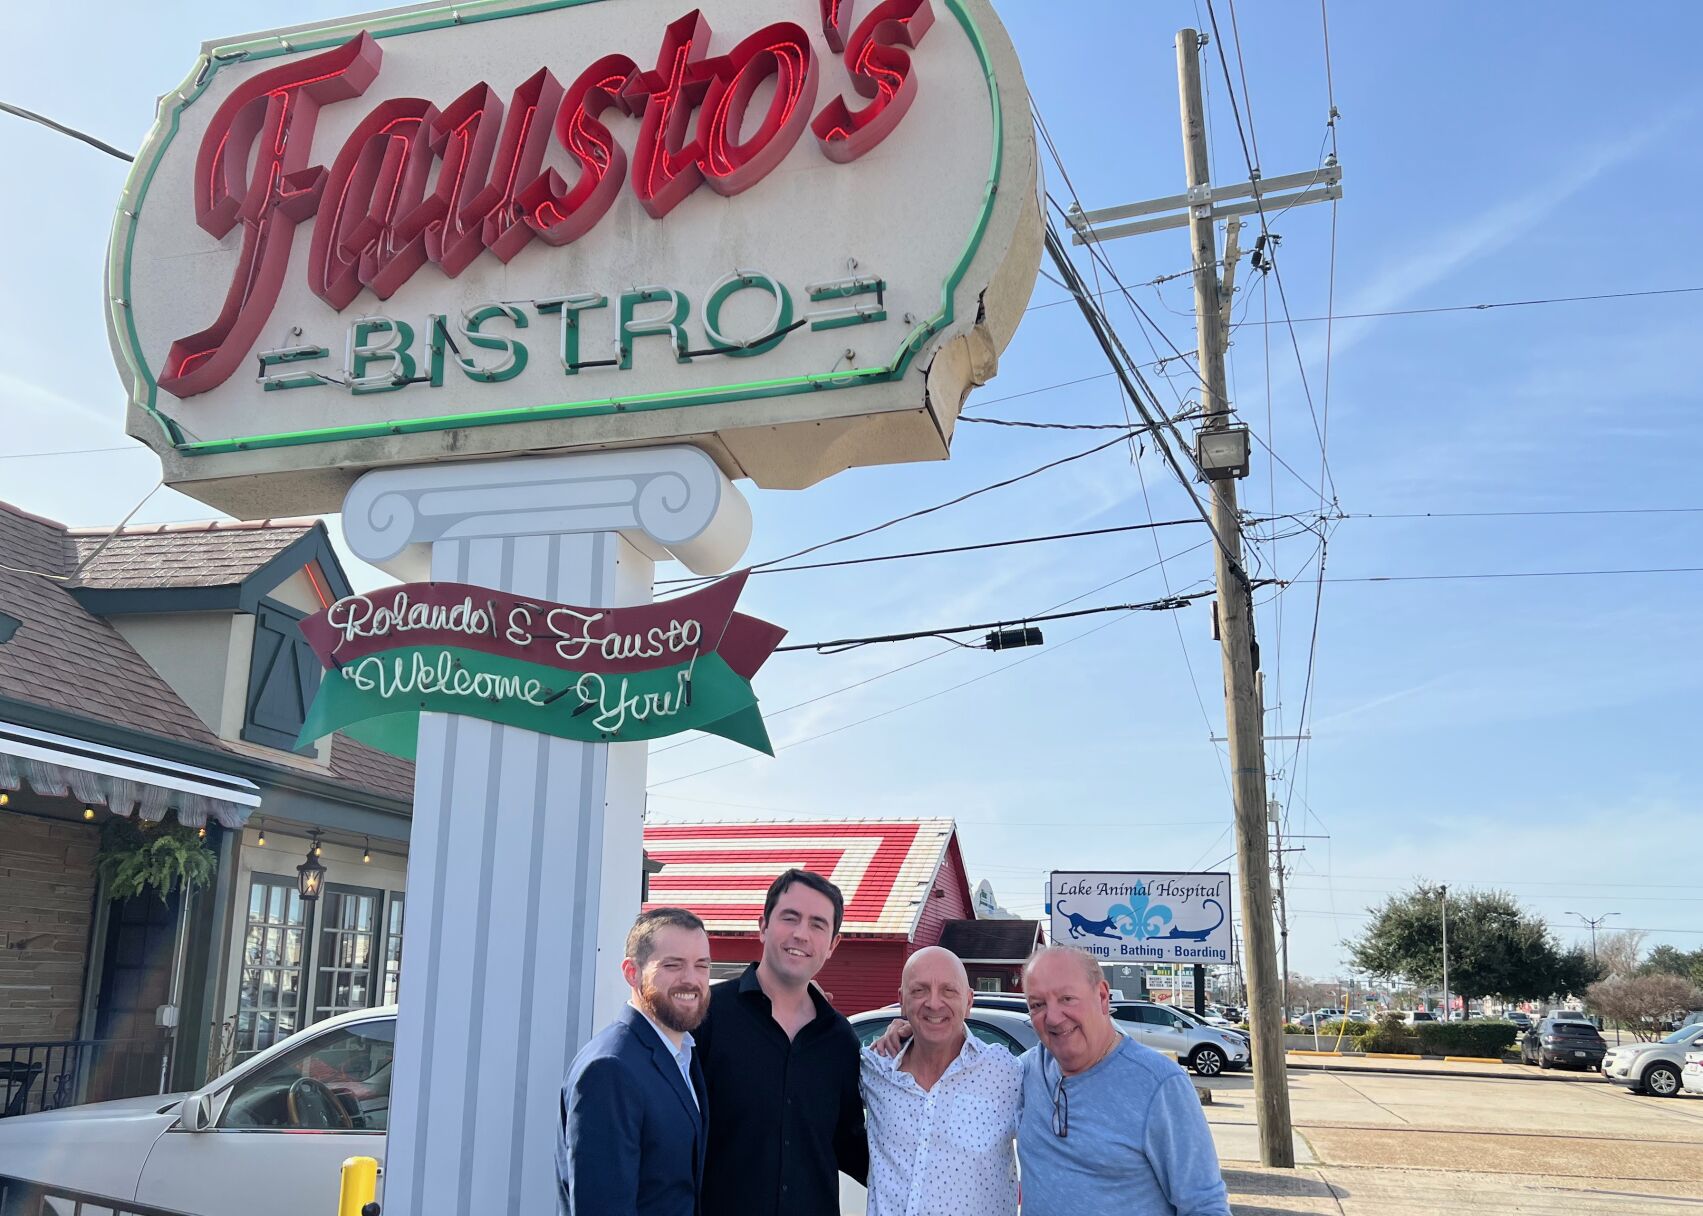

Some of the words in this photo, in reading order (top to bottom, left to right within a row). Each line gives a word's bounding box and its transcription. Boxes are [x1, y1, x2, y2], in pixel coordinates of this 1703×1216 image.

[158, 0, 935, 396] Fausto's
[344, 268, 790, 396] BISTRO
[328, 591, 490, 642] Rolando
[547, 607, 702, 660] Fausto
[341, 651, 545, 707] Welcome
[1057, 879, 1092, 896] Lake
[1096, 879, 1155, 897] Animal
[1156, 879, 1225, 904] Hospital
[1120, 944, 1164, 959] Bathing
[1174, 946, 1226, 961] Boarding
